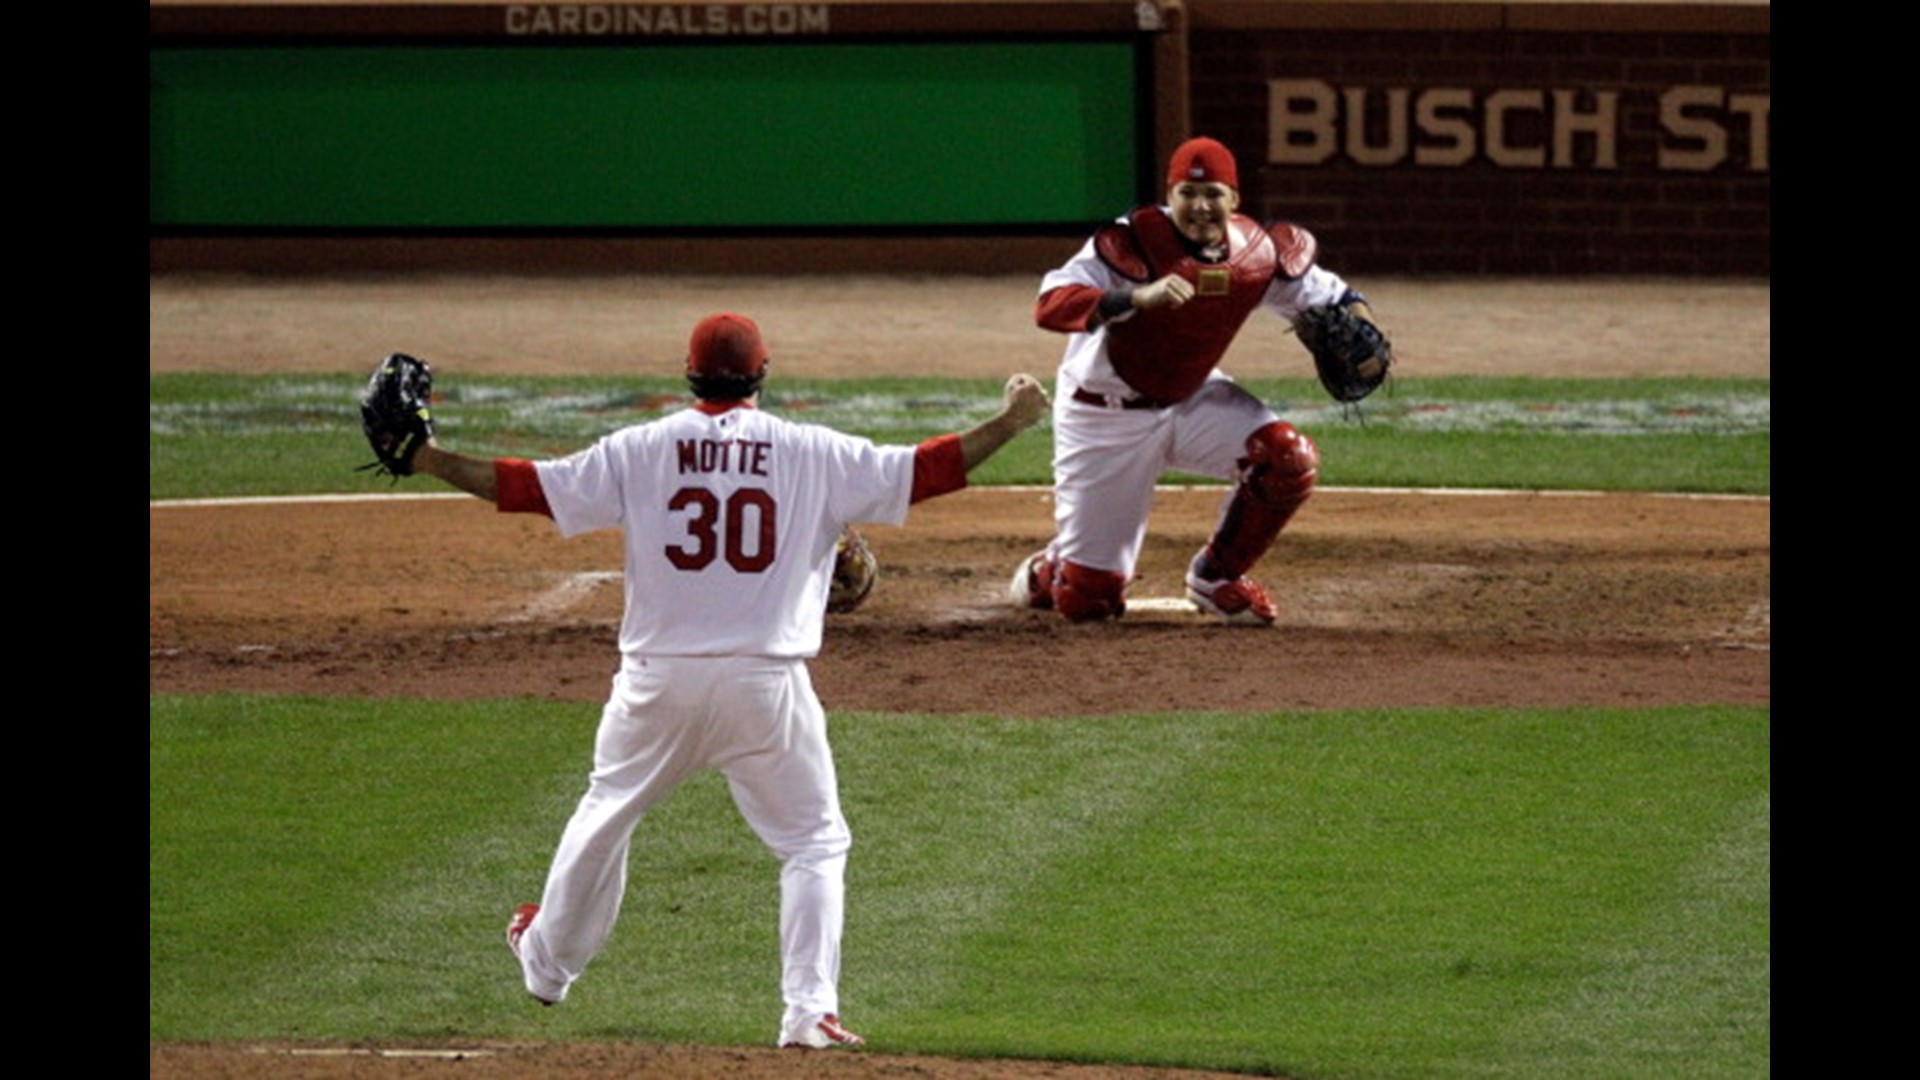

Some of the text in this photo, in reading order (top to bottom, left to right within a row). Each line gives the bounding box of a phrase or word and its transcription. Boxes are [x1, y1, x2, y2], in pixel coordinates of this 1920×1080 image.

[505, 5, 830, 34] CARDINALS.COM
[1267, 79, 1770, 171] BUSCH ST
[676, 438, 772, 477] MOTTE
[664, 486, 778, 573] 30
